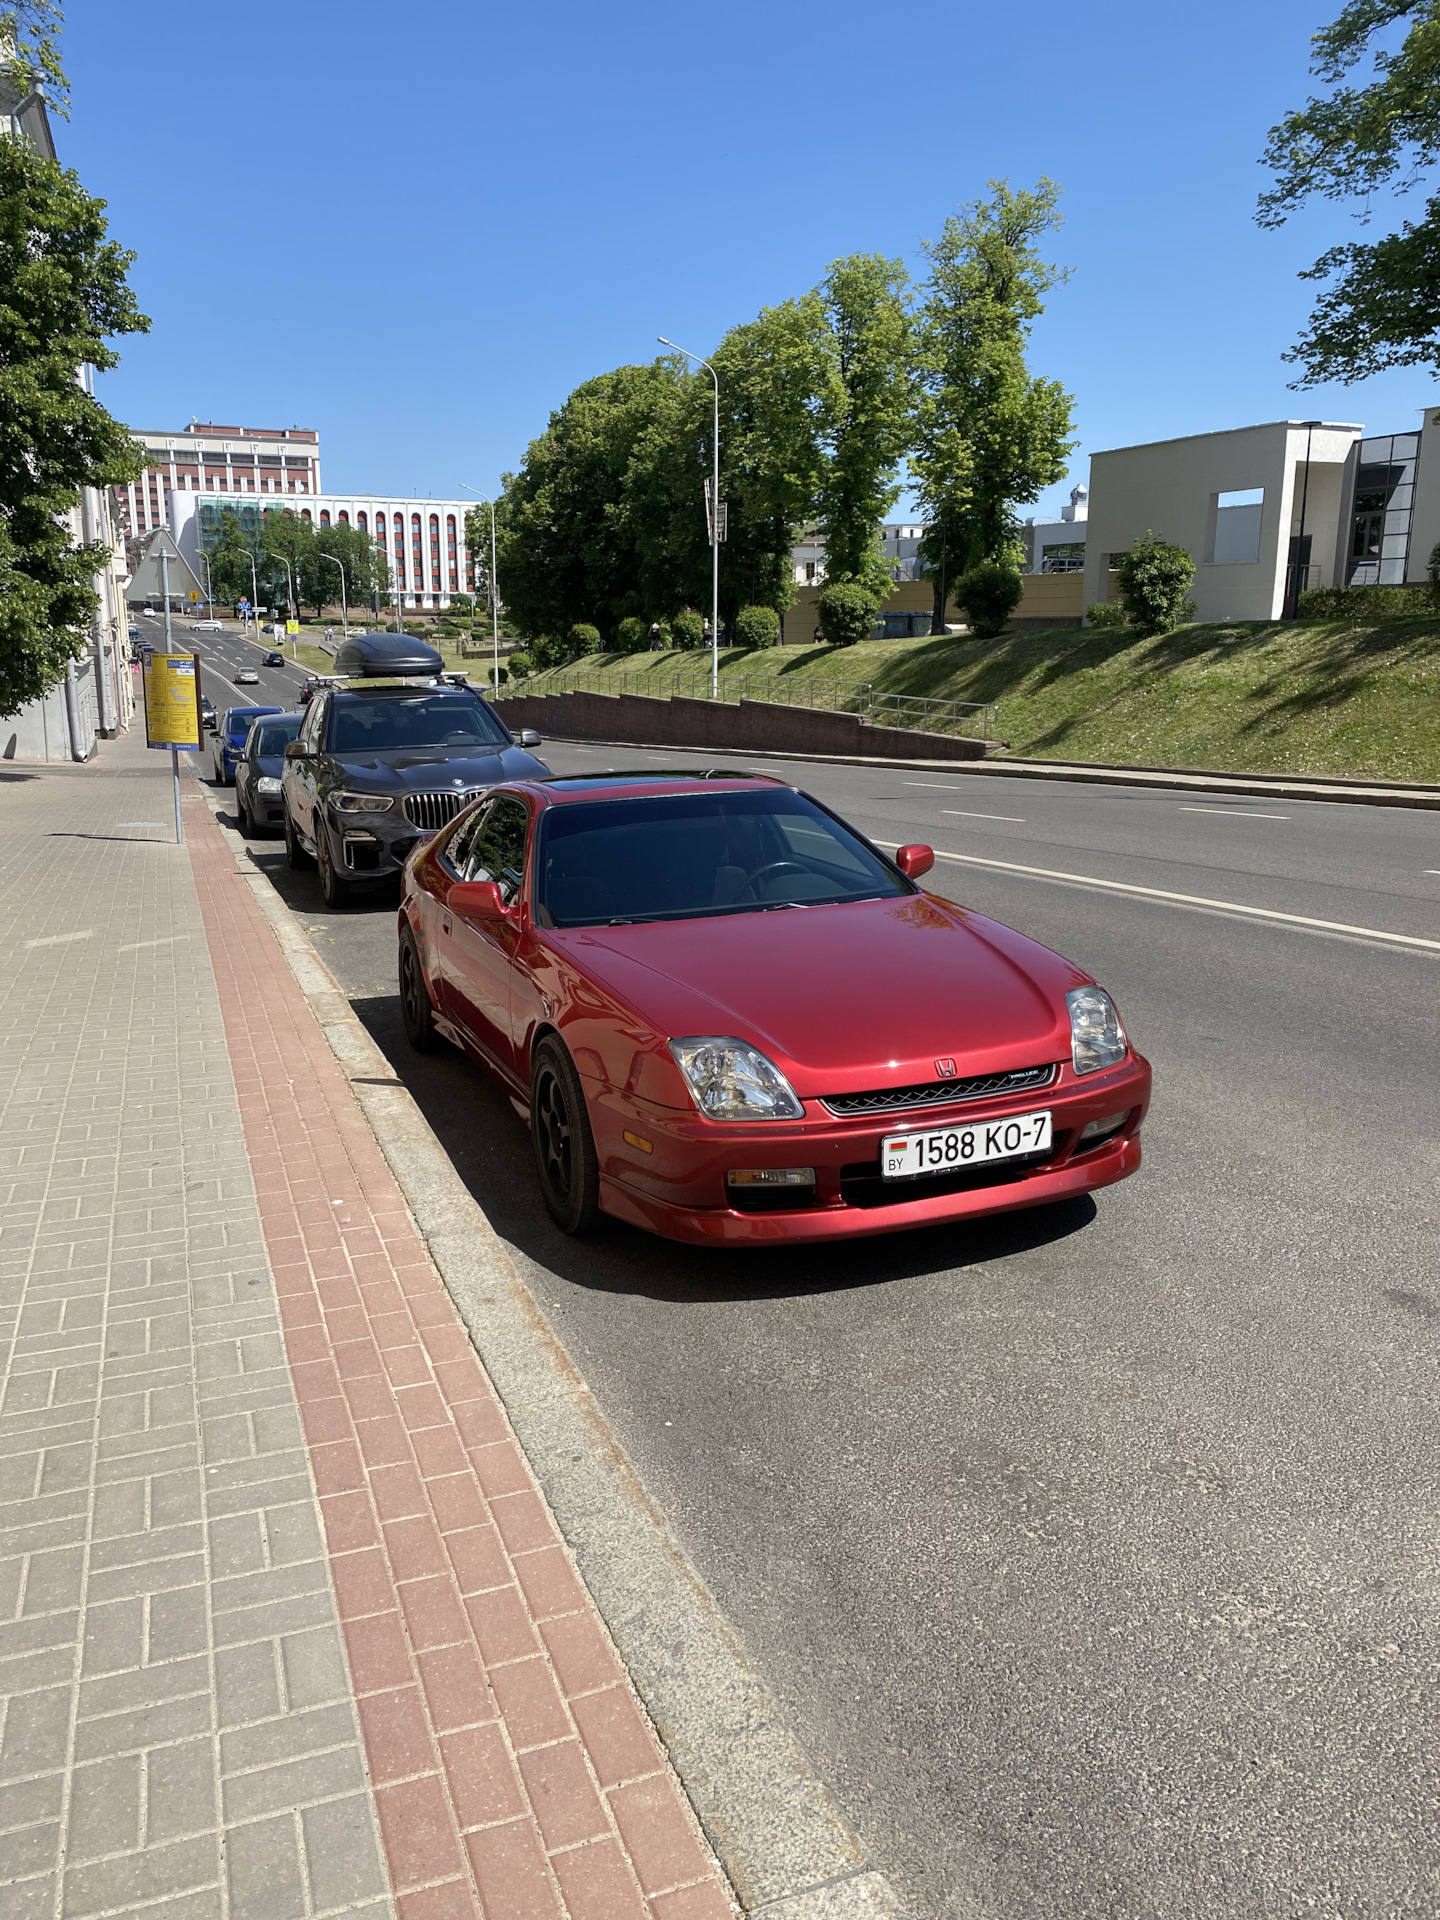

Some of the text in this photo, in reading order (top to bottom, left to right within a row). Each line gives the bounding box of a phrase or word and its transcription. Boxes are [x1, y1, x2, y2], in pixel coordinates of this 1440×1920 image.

[915, 1117, 1046, 1167] 1588 KO-7
[888, 1158, 904, 1171] BY
